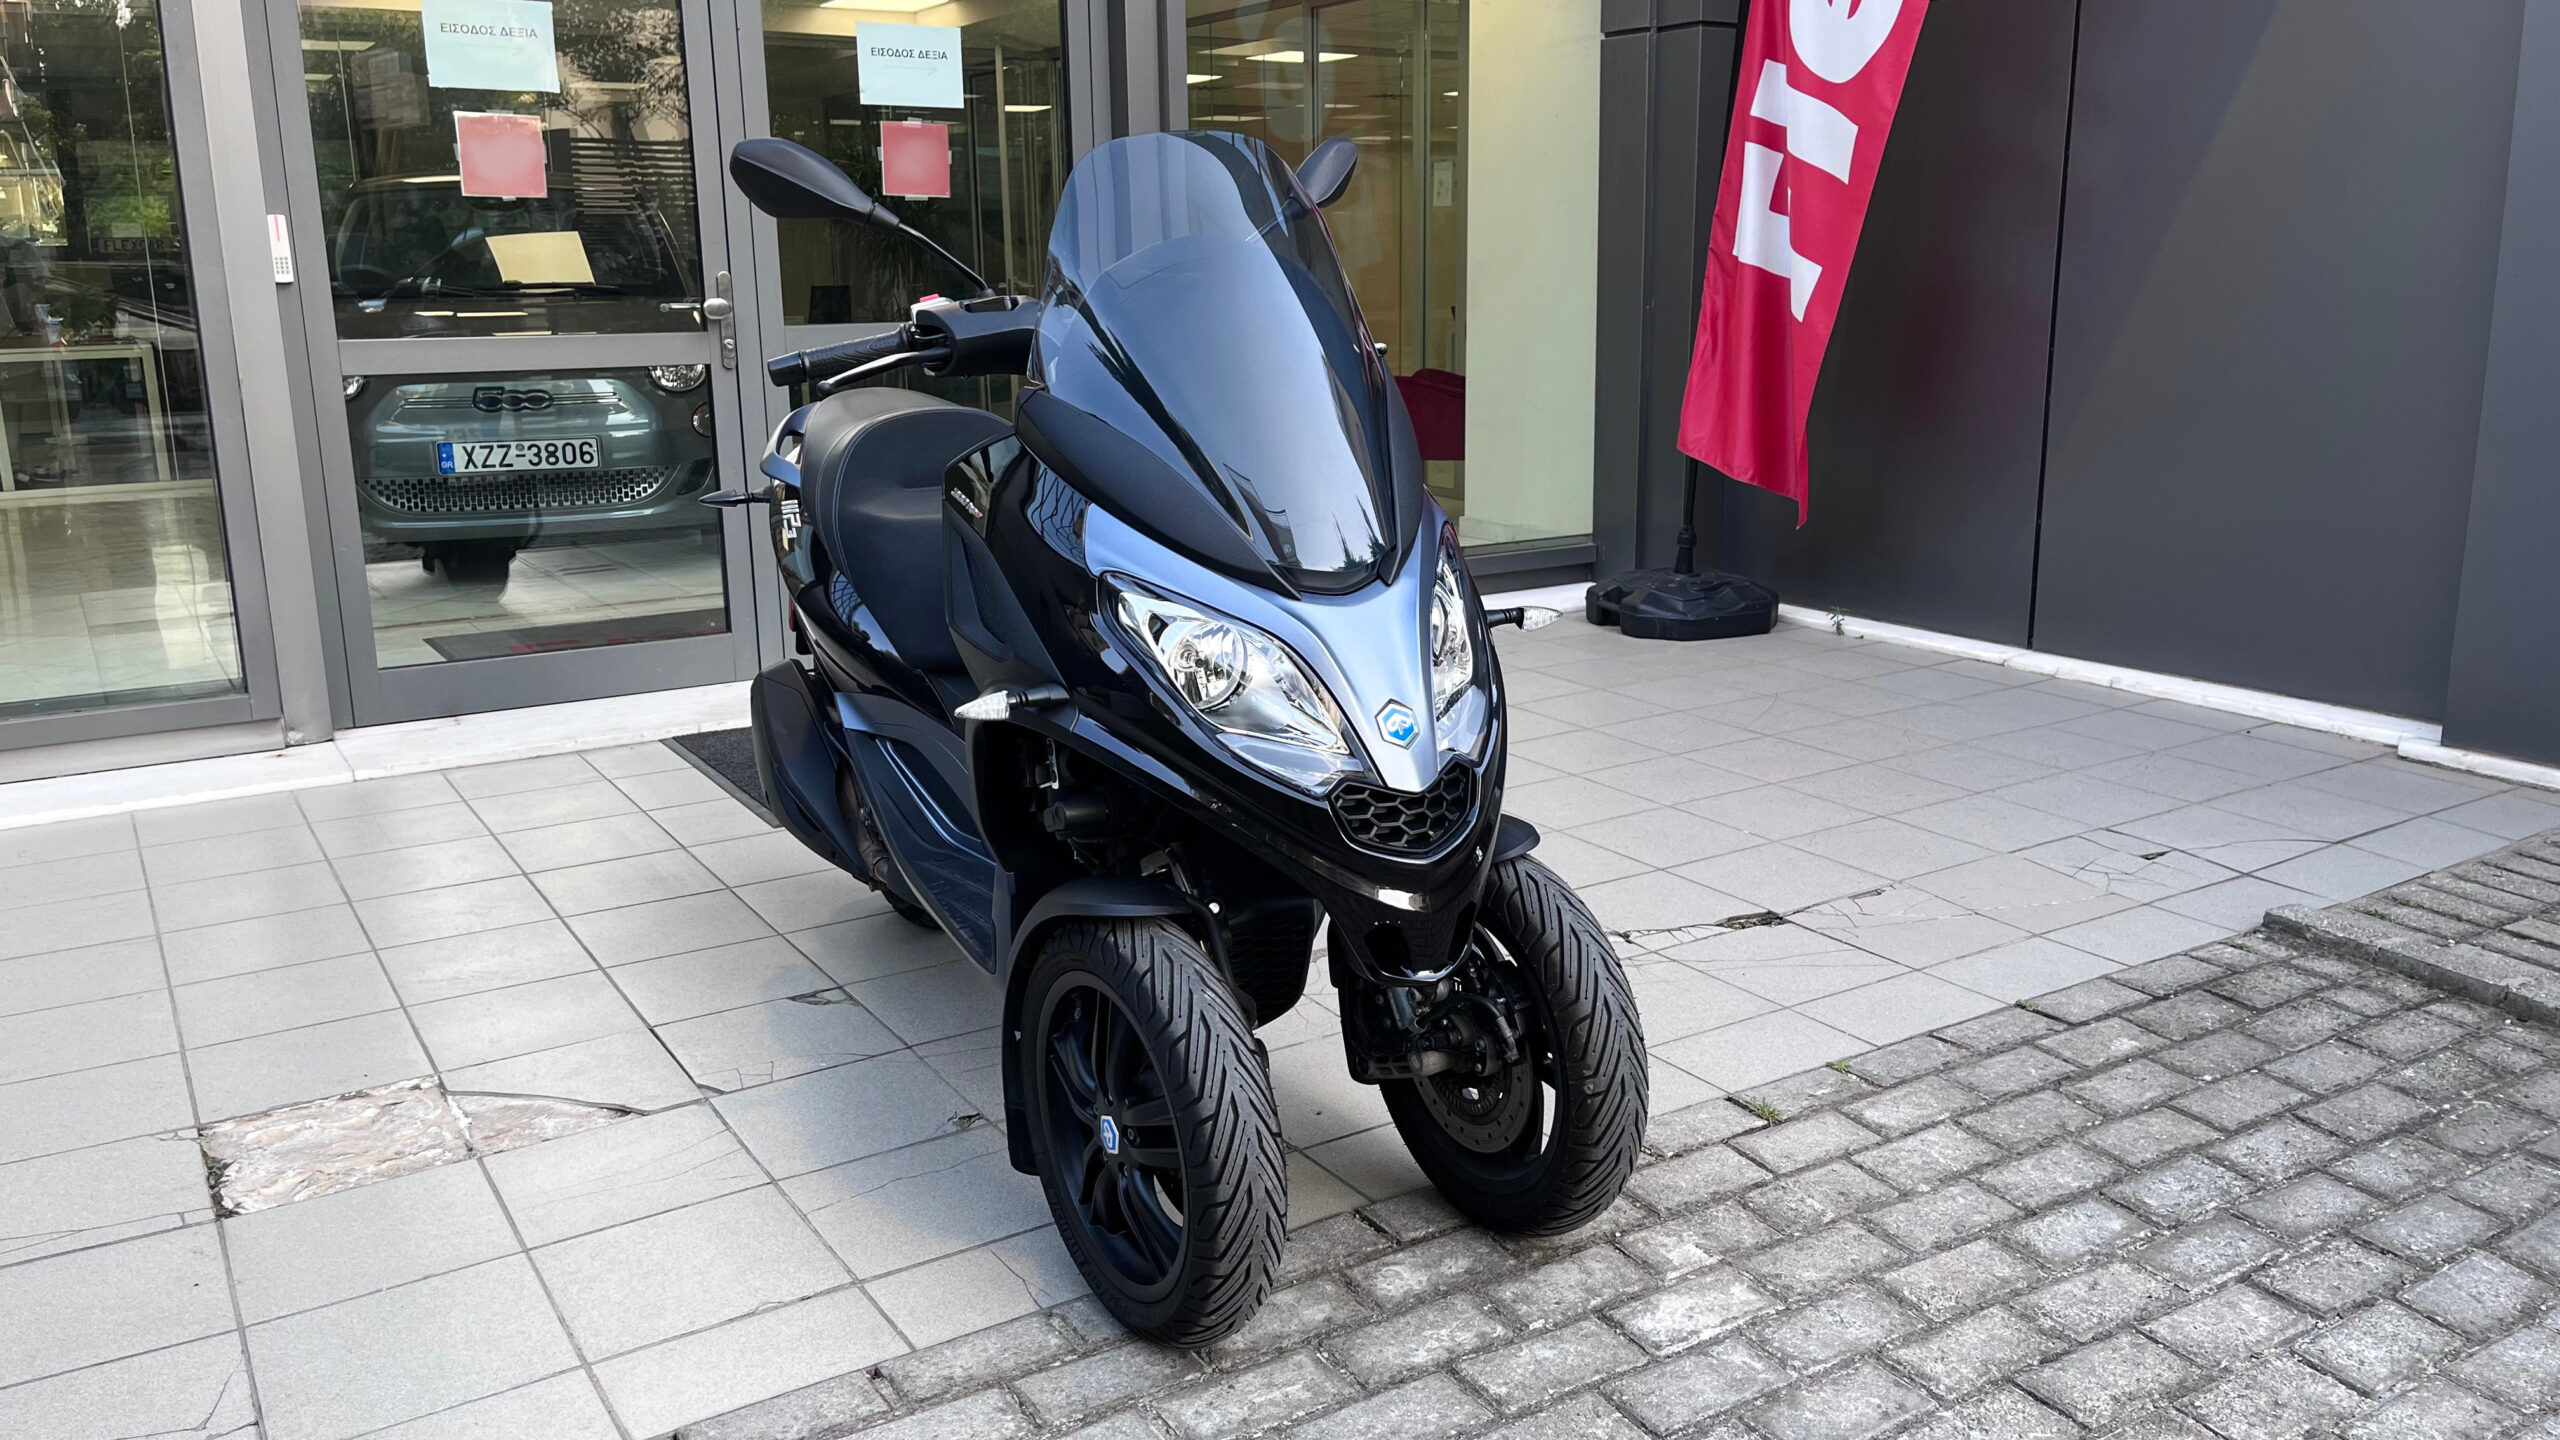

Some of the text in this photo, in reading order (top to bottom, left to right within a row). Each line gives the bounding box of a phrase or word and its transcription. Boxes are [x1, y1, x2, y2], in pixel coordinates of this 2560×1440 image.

[440, 23, 538, 39] ΕΙΣΟΔΟΣ ΔΕΞΙΑ
[870, 47, 948, 60] ΕΙΣΟΔΟΣ ΔΕΞΙΑ
[472, 387, 553, 413] 500
[441, 441, 595, 469] GR XZZ-3806
